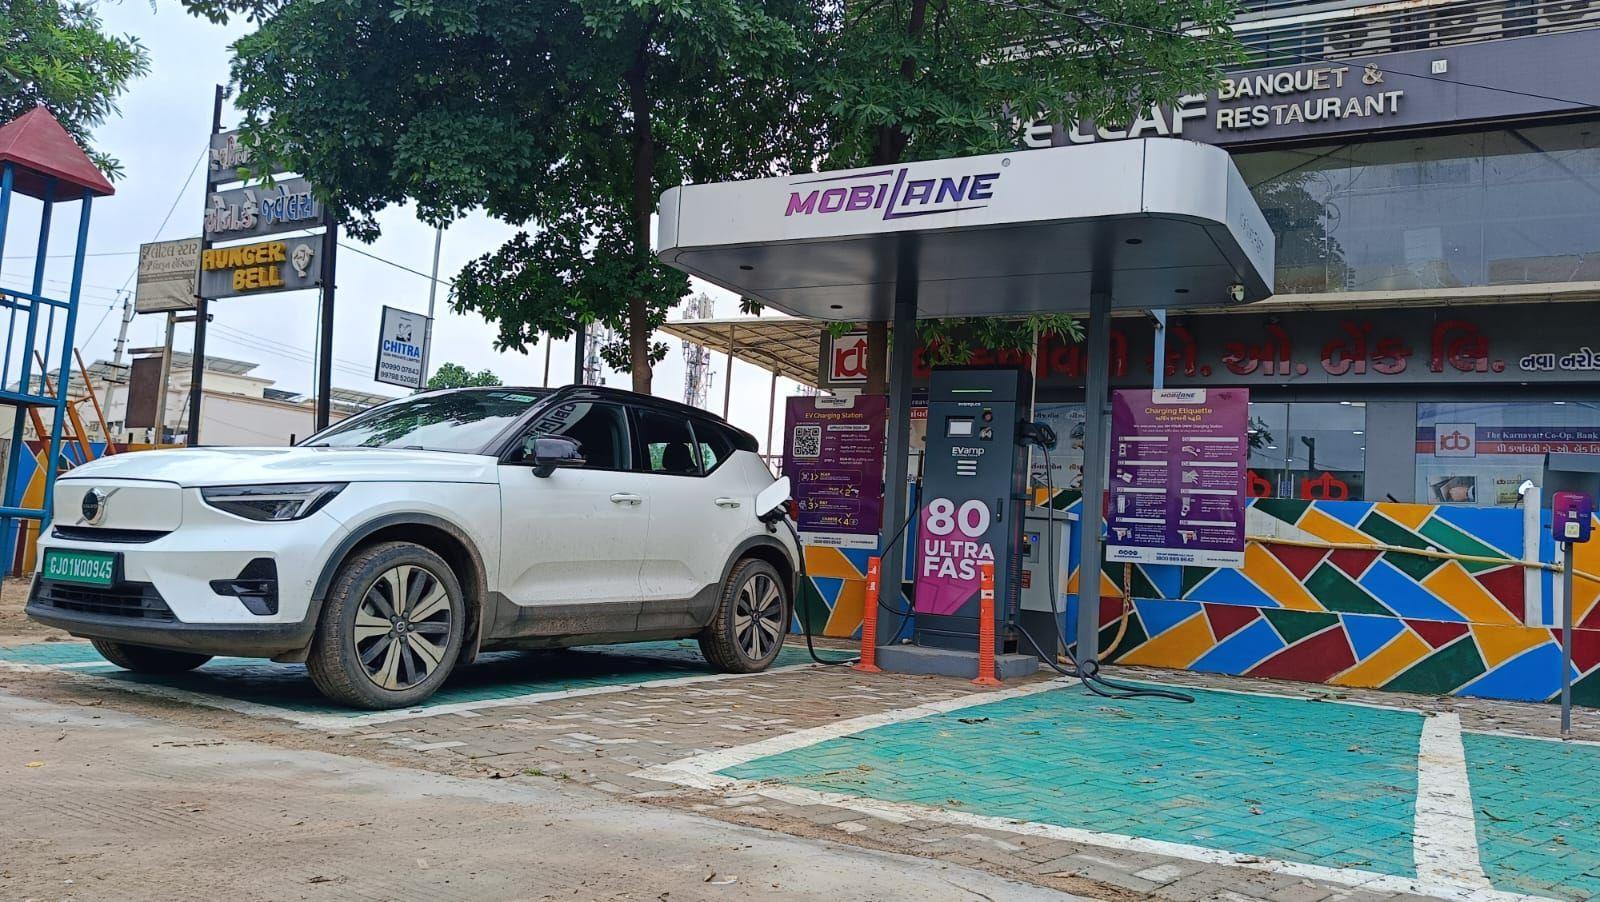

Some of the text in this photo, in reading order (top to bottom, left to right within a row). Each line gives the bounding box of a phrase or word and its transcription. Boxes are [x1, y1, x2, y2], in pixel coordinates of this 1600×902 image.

[1218, 62, 1384, 99] BANQUET &
[1216, 90, 1404, 130] RESTAURANT
[785, 168, 1000, 220] MOBILANE
[203, 242, 287, 272] HUNGER
[233, 265, 285, 290] BELL
[383, 339, 420, 358] CHITRA
[1519, 352, 1555, 371] નવા
[814, 412, 841, 420] Charging
[1144, 407, 1212, 417] Charging Etiquette
[1486, 431, 1499, 439] The
[951, 446, 985, 456] EVamp
[843, 518, 849, 526] 4
[926, 498, 990, 538] 80
[924, 539, 994, 560] ULTRA
